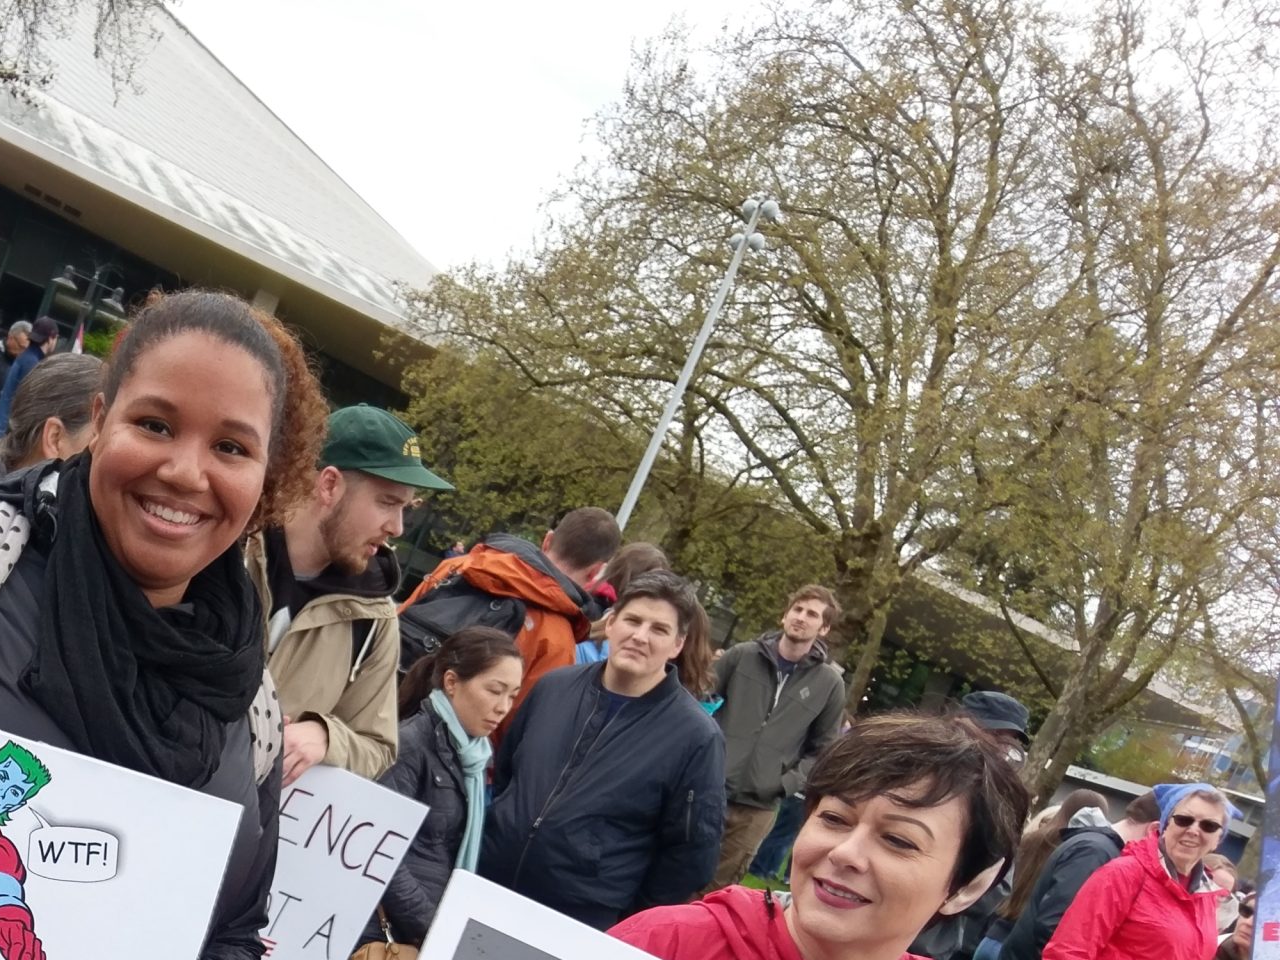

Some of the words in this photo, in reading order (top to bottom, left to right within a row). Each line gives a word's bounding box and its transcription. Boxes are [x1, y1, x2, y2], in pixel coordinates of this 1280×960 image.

[38, 839, 108, 866] WTF!
[278, 787, 409, 885] ENCE
[302, 913, 336, 960] A
